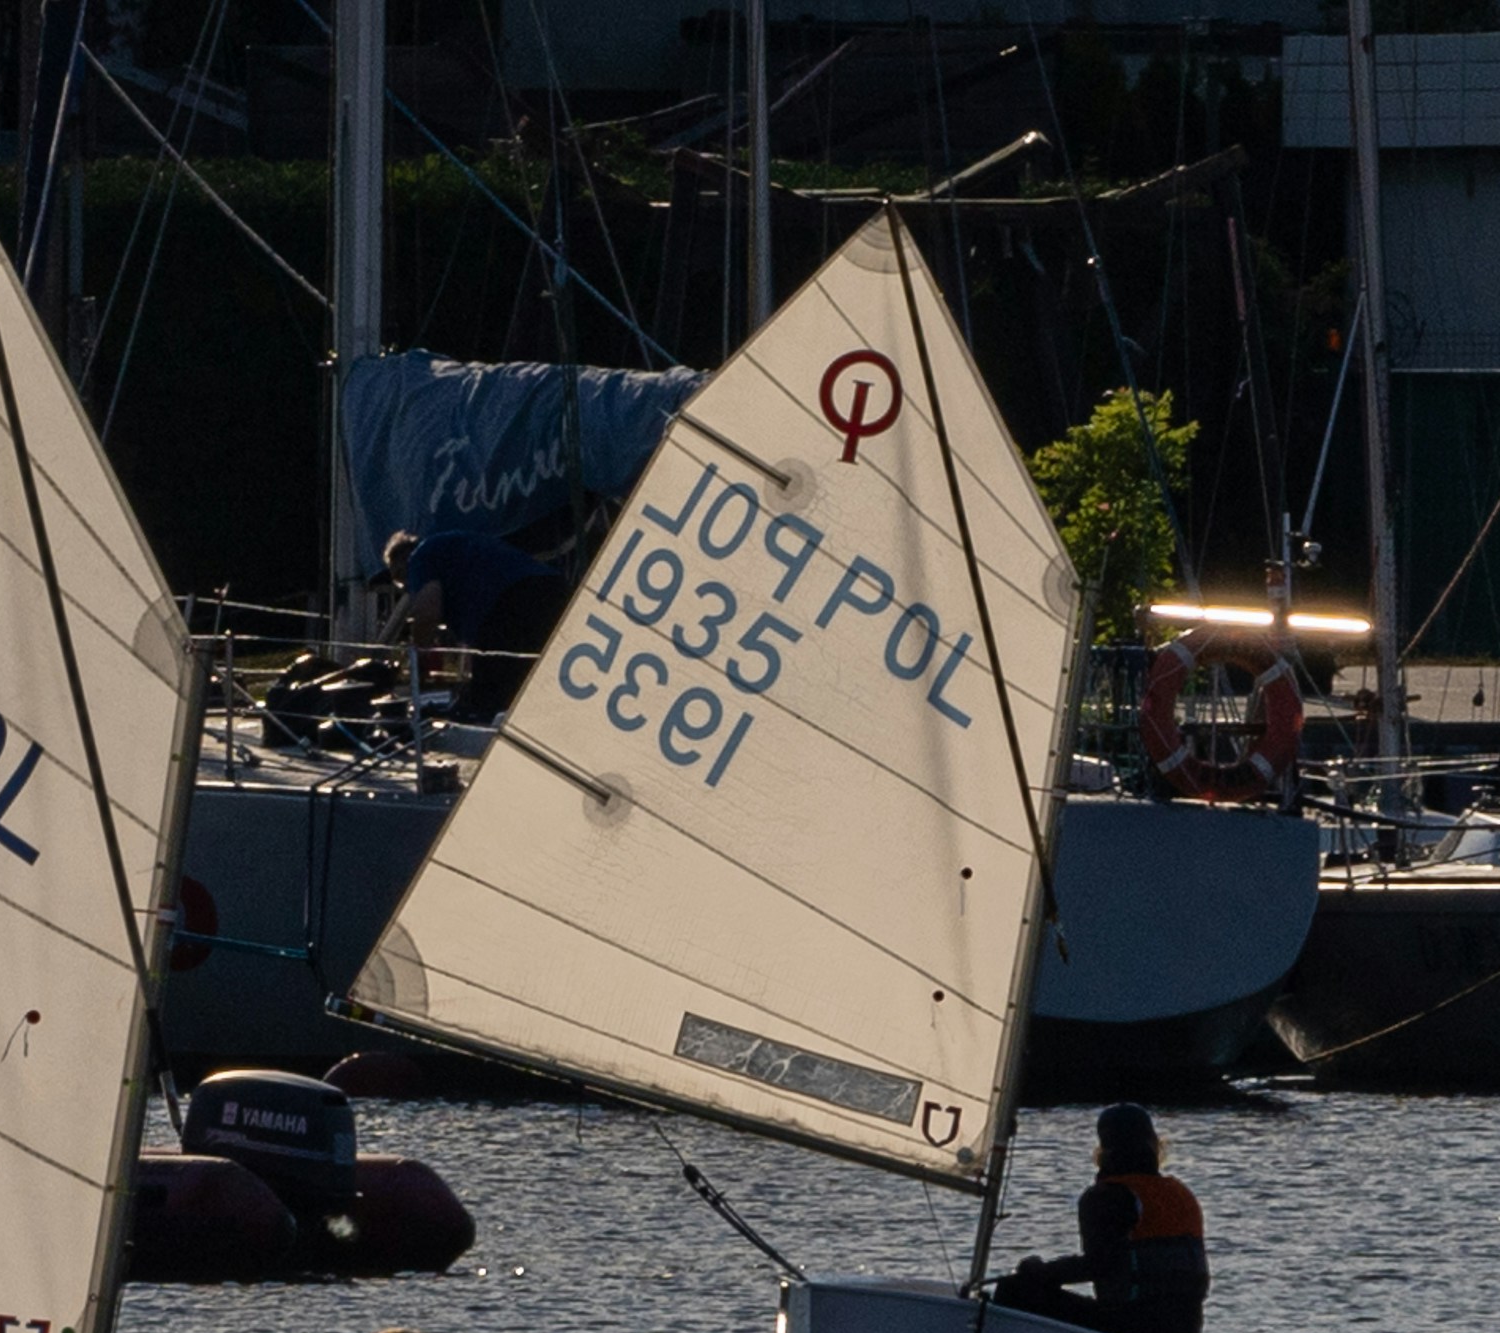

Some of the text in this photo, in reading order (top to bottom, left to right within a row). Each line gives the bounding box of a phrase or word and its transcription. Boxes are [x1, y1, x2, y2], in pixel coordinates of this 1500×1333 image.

[596, 529, 804, 695] 1935
[814, 555, 973, 730] POL
[241, 1106, 308, 1136] YAMAHA
